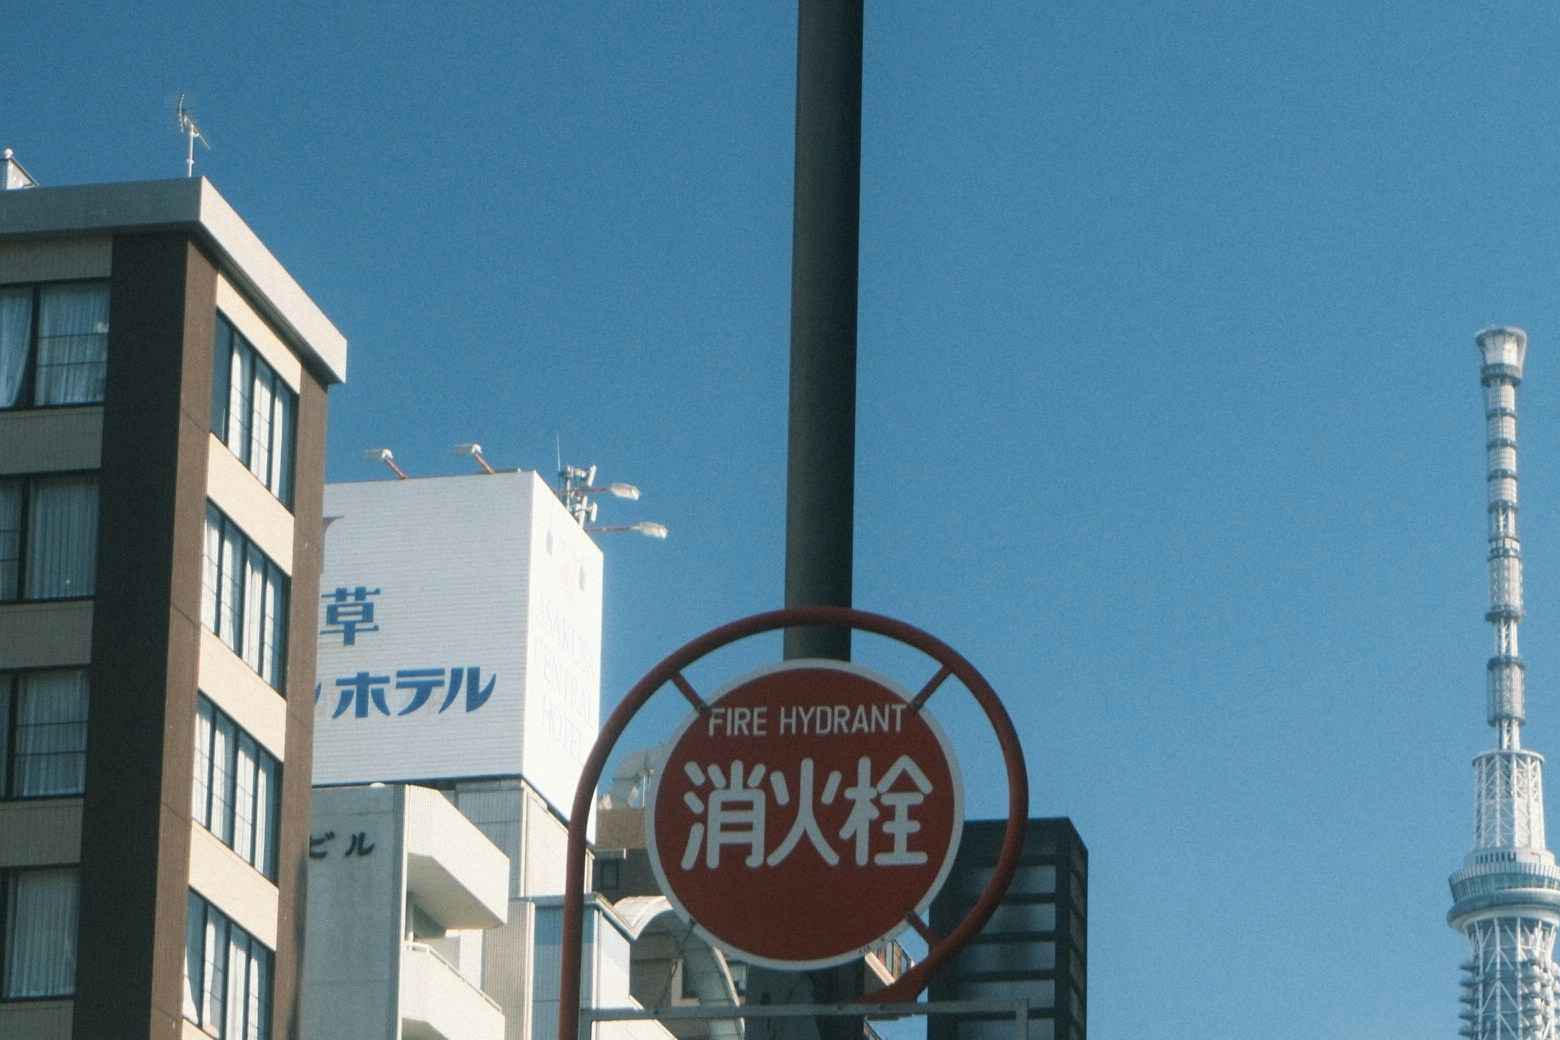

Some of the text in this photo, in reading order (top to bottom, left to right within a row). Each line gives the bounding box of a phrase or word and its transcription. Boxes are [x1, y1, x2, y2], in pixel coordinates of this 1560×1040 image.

[320, 586, 381, 646] 草
[314, 666, 497, 719] ホテル
[534, 638, 596, 731] CENTRAL
[541, 694, 584, 766] HOTEL
[708, 703, 907, 737] FIRE HYDRANT
[681, 754, 934, 871] 消火栓
